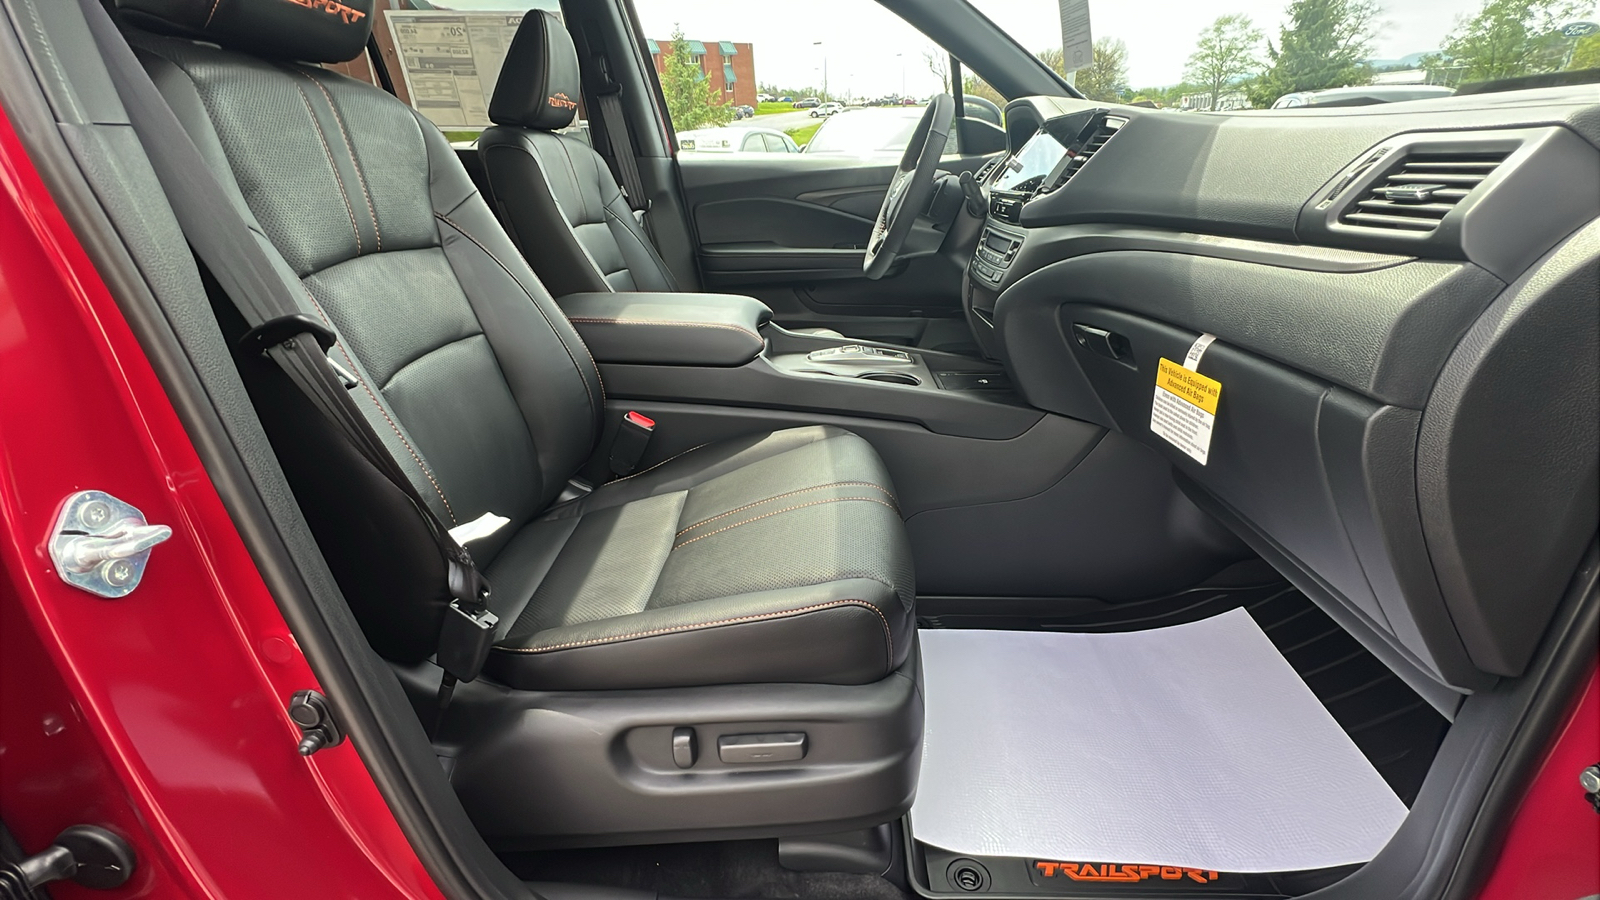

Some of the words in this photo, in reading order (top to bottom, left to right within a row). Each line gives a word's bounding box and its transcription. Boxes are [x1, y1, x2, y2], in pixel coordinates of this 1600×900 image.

[1167, 378, 1187, 394] Advanced
[1193, 391, 1204, 403] Bags
[1168, 367, 1183, 381] Vehicle
[1187, 376, 1209, 393] Equipped
[1207, 387, 1219, 398] with
[1036, 862, 1219, 884] TRAILSPORT
